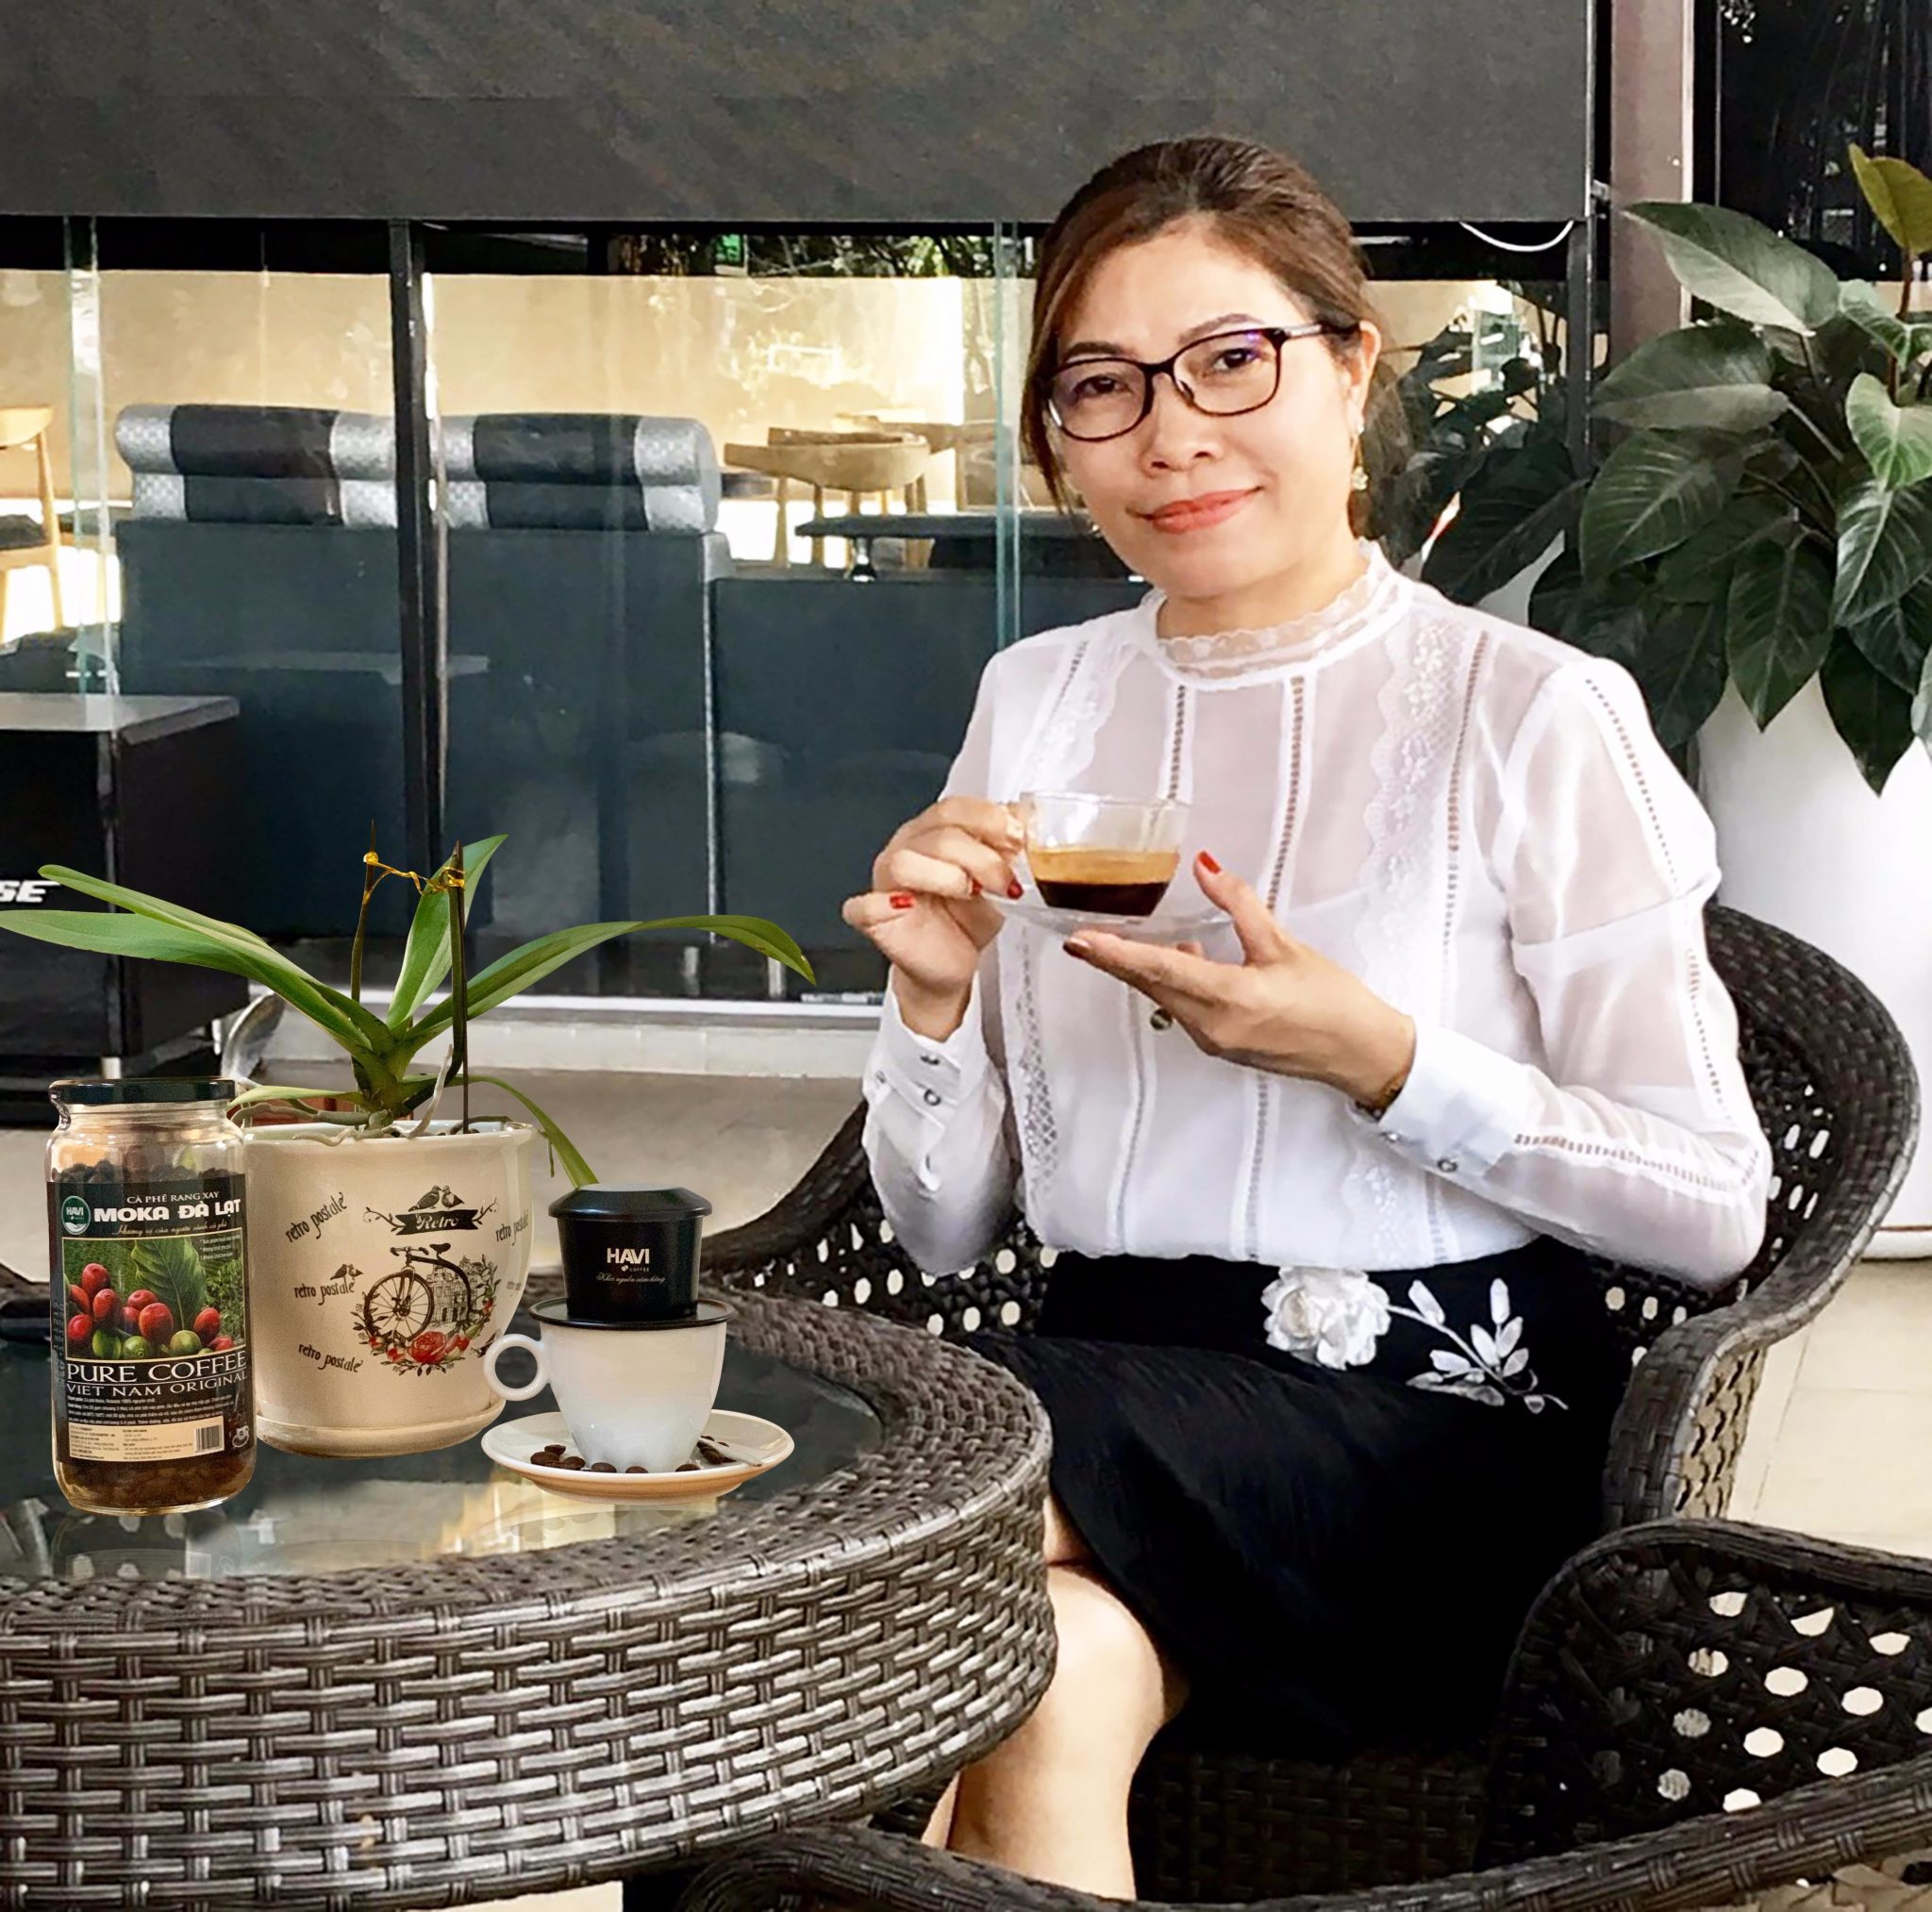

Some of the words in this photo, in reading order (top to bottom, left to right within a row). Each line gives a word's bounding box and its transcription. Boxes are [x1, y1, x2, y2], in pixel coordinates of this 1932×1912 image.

[126, 1193, 142, 1204] CÀ
[145, 1193, 169, 1204] PHÊ
[171, 1193, 201, 1202] RANG
[202, 1190, 220, 1200] XAY
[94, 1206, 170, 1222] MOKA
[177, 1201, 209, 1219] ĐÀ
[215, 1199, 242, 1217] LẠT
[285, 1221, 310, 1242] retro
[309, 1191, 348, 1239] postale
[415, 1213, 458, 1230] Retro
[495, 1223, 512, 1242] retro
[607, 1248, 650, 1264] HAVI
[294, 1283, 316, 1299] retro
[318, 1279, 356, 1305] postale
[67, 1363, 137, 1383] PURE
[148, 1350, 247, 1380] COFFEE
[298, 1343, 322, 1362] retro
[317, 1354, 364, 1373] postale
[66, 1383, 105, 1396] VIET
[112, 1386, 161, 1397] NAM
[170, 1371, 248, 1394] ORIGINAL
